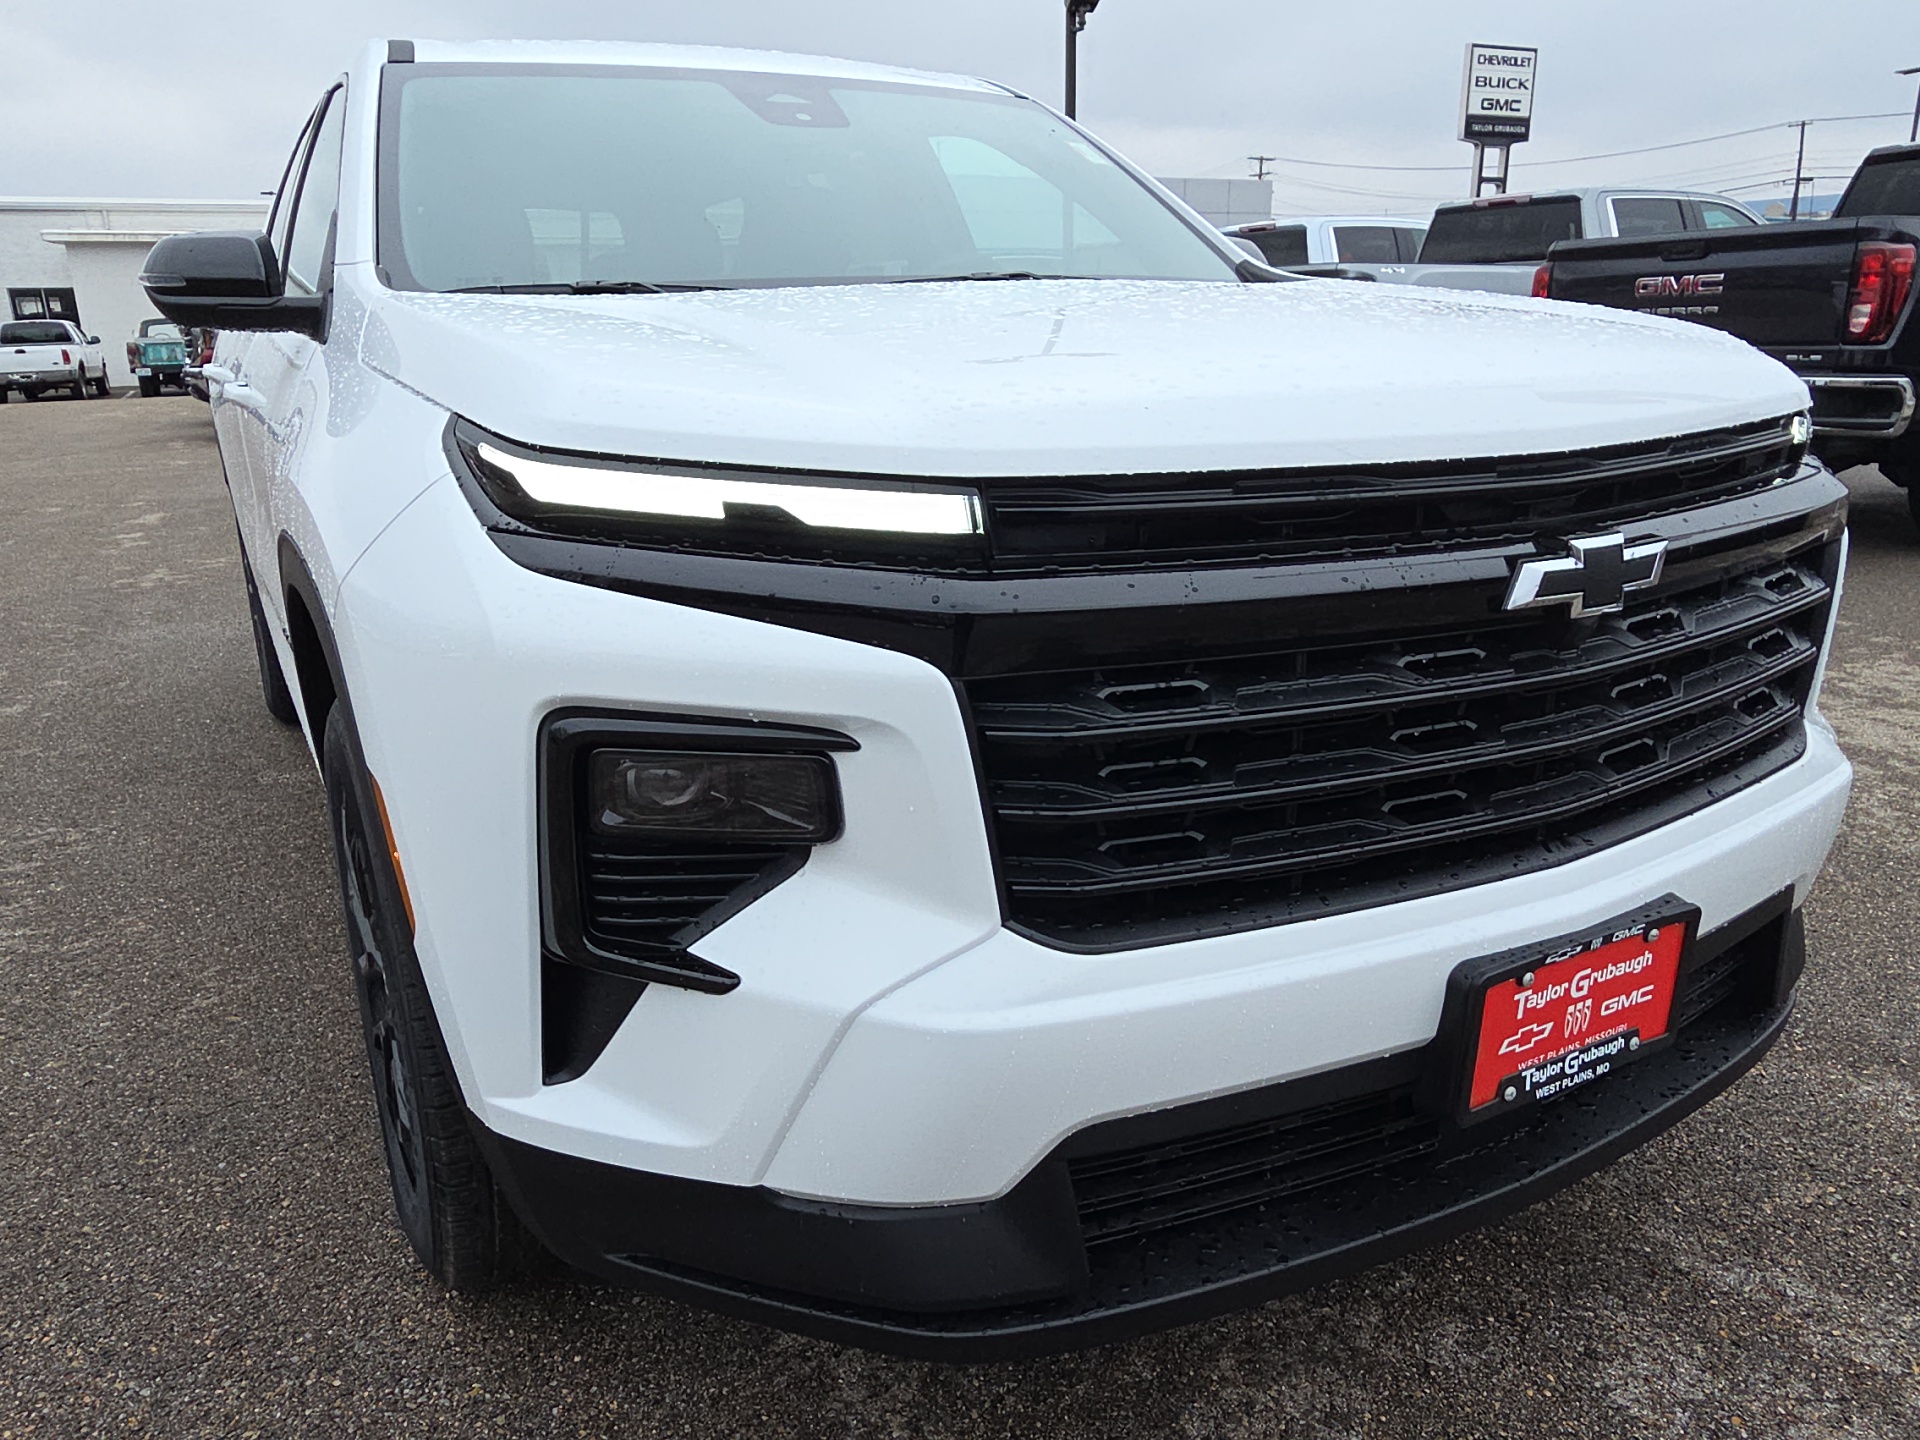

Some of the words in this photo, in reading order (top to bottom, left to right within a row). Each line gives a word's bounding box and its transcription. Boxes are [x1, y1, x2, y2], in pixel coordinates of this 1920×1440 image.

[1477, 53, 1532, 68] CHEVROLET
[1475, 75, 1530, 90] BUICK
[1480, 97, 1522, 112] GMC
[1471, 123, 1493, 132] TAYLOR
[1634, 273, 1725, 298] GMC
[1612, 923, 1646, 942] GMC
[1513, 981, 1569, 1020] Taylor
[1569, 950, 1653, 998] Grubaugh
[1600, 984, 1654, 1017] GMC
[1517, 1054, 1545, 1071] WEST
[1584, 1022, 1628, 1046] MISSOURI
[1521, 1061, 1563, 1092] Taylor
[1564, 1036, 1625, 1075] Grubaugh
[1535, 1080, 1561, 1100] WEST
[1562, 1068, 1595, 1089] PLAINS,
[1596, 1061, 1610, 1076] MO
